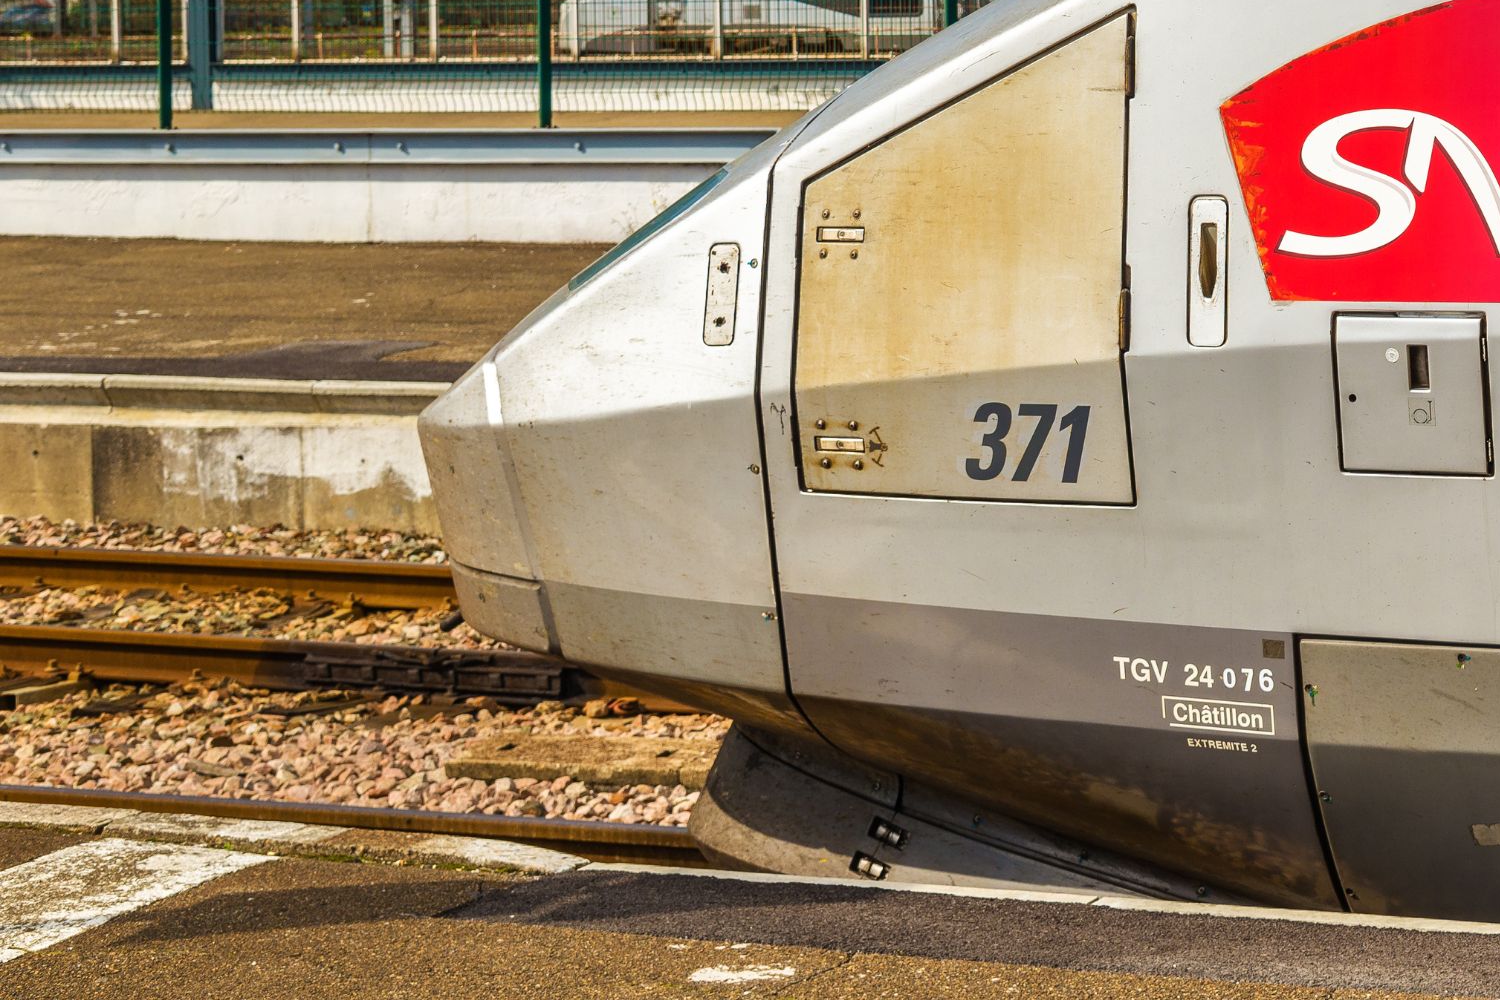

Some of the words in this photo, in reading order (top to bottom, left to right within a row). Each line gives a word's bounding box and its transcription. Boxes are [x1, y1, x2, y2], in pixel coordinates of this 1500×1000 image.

[965, 402, 1091, 484] 371
[1113, 656, 1168, 683] TGV
[1173, 702, 1263, 729] Châtillon
[1187, 738, 1249, 752] EXTREMITE
[1250, 743, 1258, 753] 2
